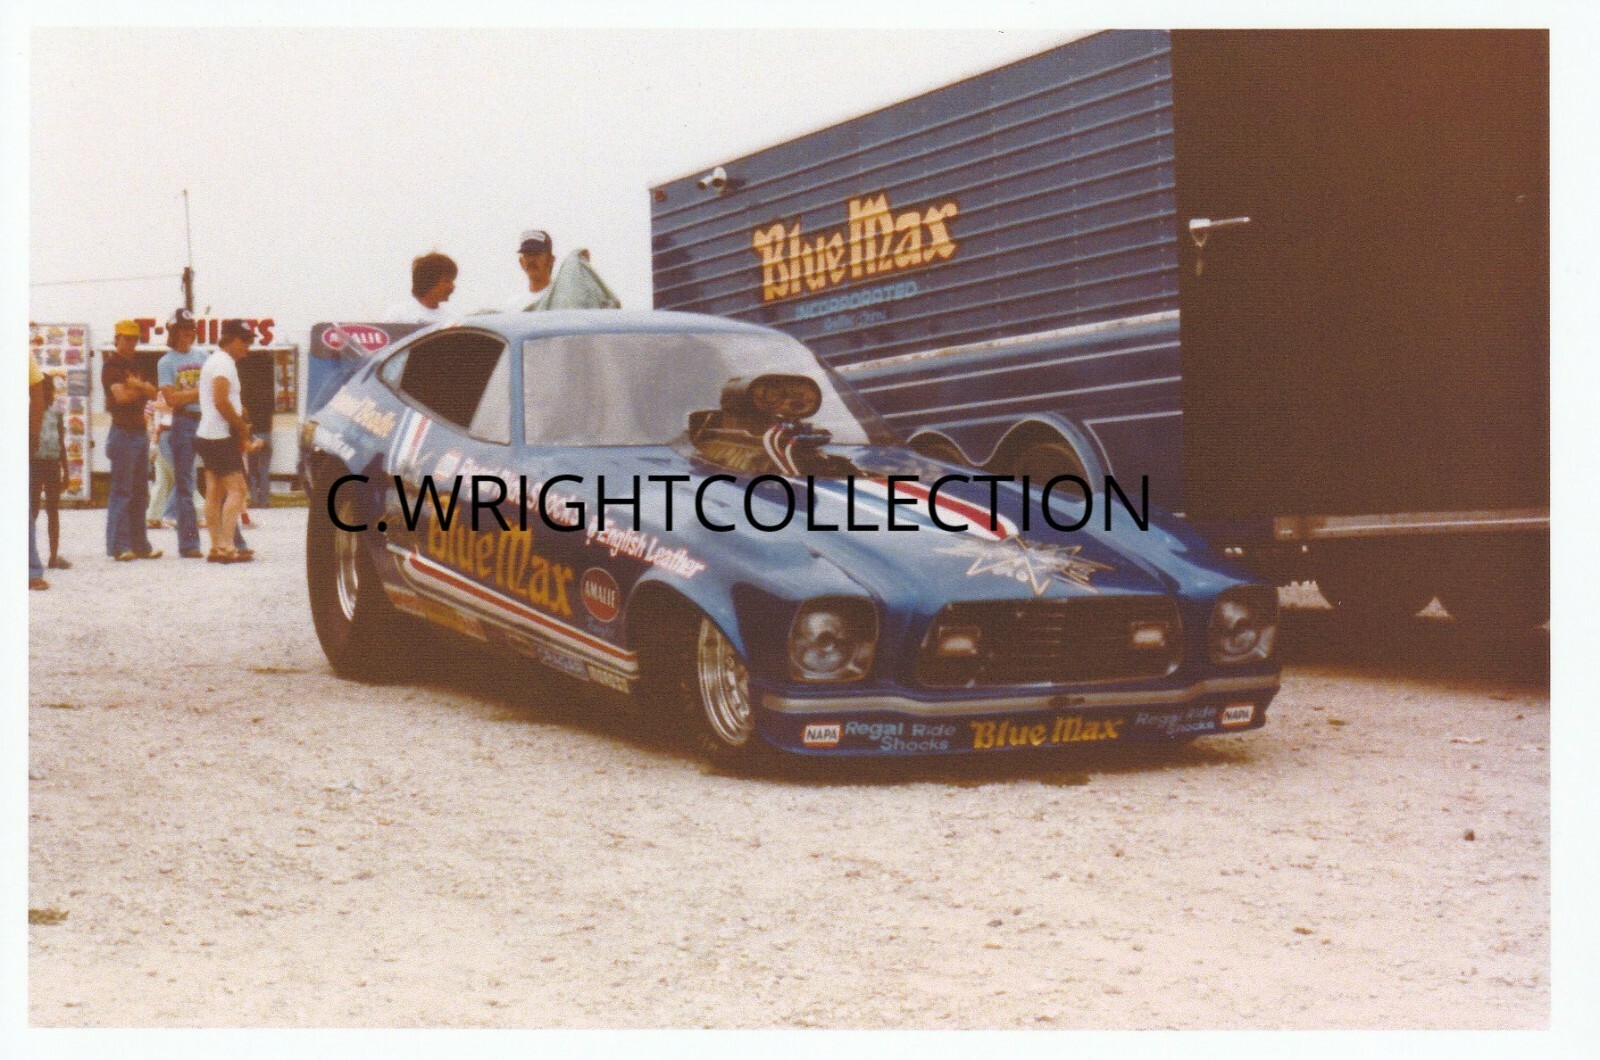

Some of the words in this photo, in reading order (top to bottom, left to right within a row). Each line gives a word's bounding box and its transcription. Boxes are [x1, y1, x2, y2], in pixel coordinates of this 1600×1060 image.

[752, 222, 847, 303] Blue
[848, 193, 960, 281] Max
[643, 536, 706, 580] Leather
[805, 727, 839, 741] NAPA
[844, 720, 904, 741] Regal
[912, 723, 957, 737] Ride
[880, 735, 949, 751] Shocks
[969, 719, 1047, 749] Blue
[1051, 715, 1125, 743] Max
